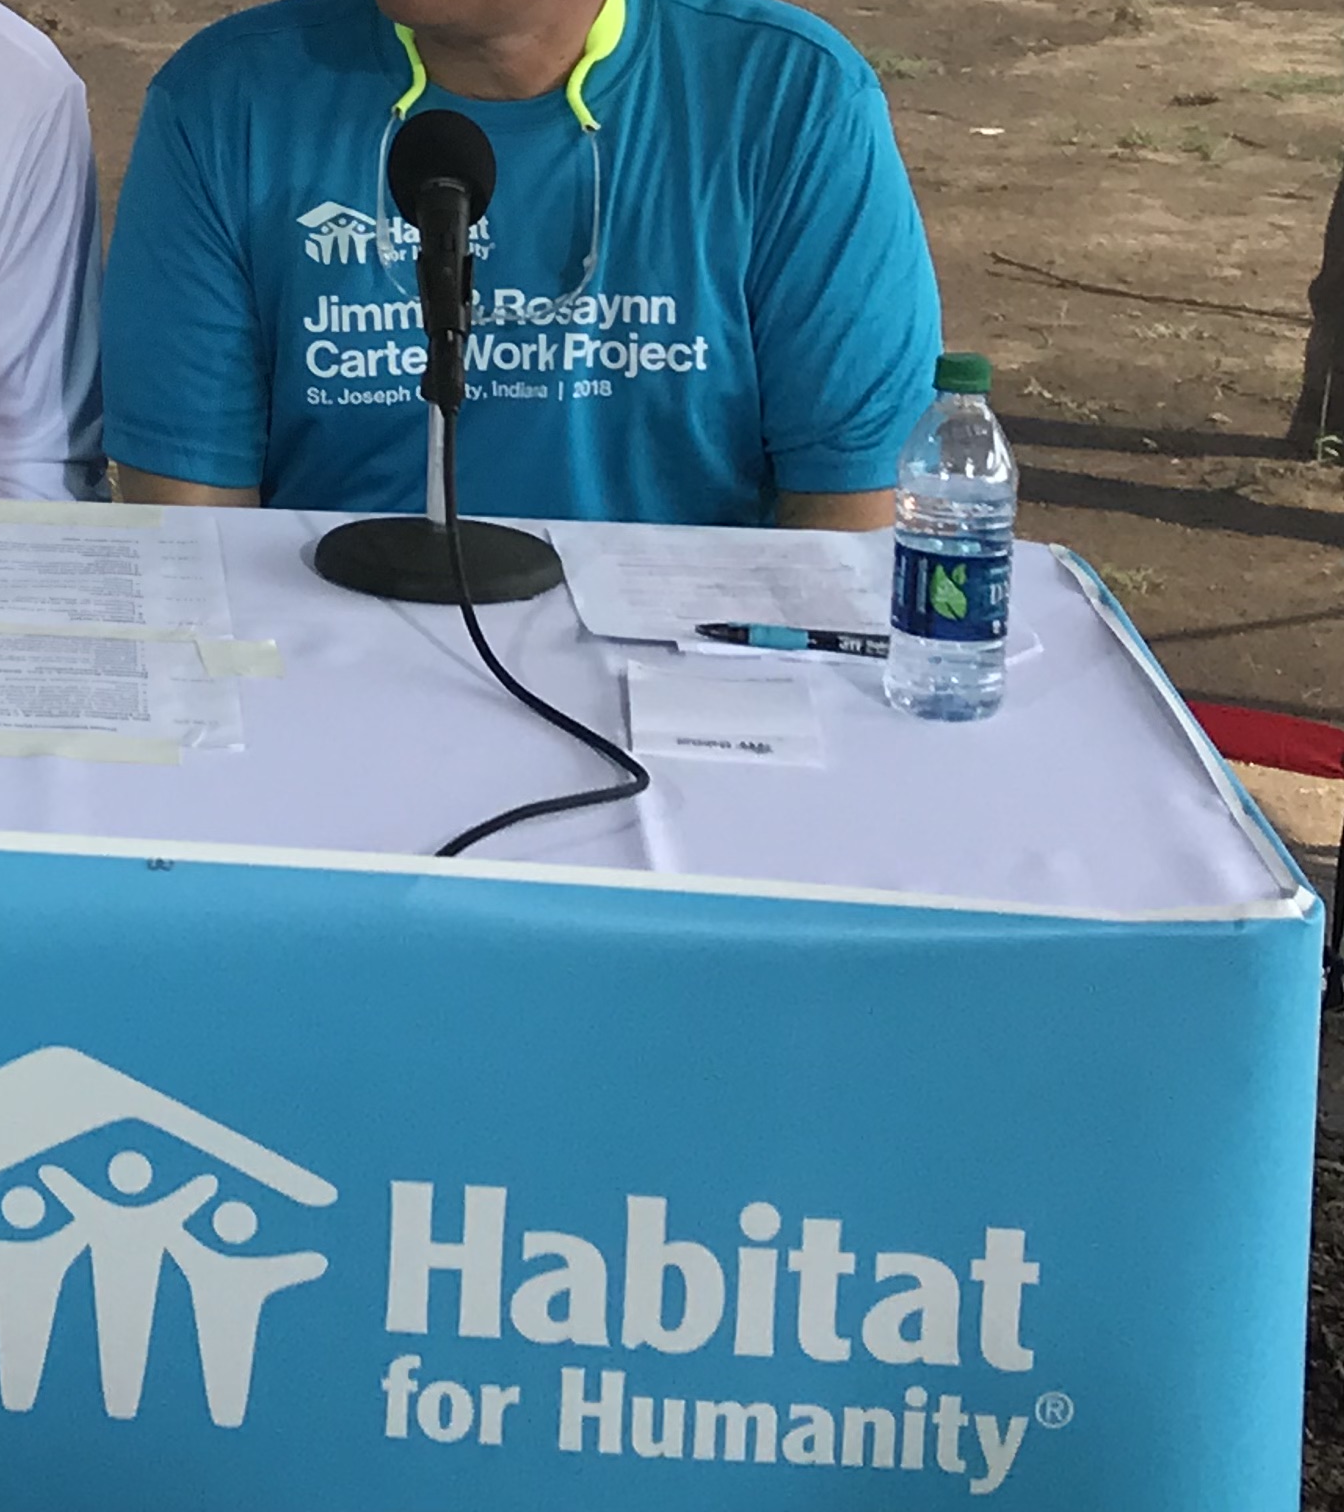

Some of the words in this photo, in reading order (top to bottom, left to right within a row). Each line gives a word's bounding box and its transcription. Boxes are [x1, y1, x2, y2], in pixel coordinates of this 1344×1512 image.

[304, 295, 424, 333] Jimm
[306, 340, 428, 378] Carte
[464, 333, 558, 372] Work
[563, 332, 708, 378] Project
[307, 387, 333, 405] St.
[338, 386, 411, 406] Joseph
[573, 379, 613, 399] 2018
[385, 1180, 1040, 1372] Habitat
[381, 1354, 520, 1445] for
